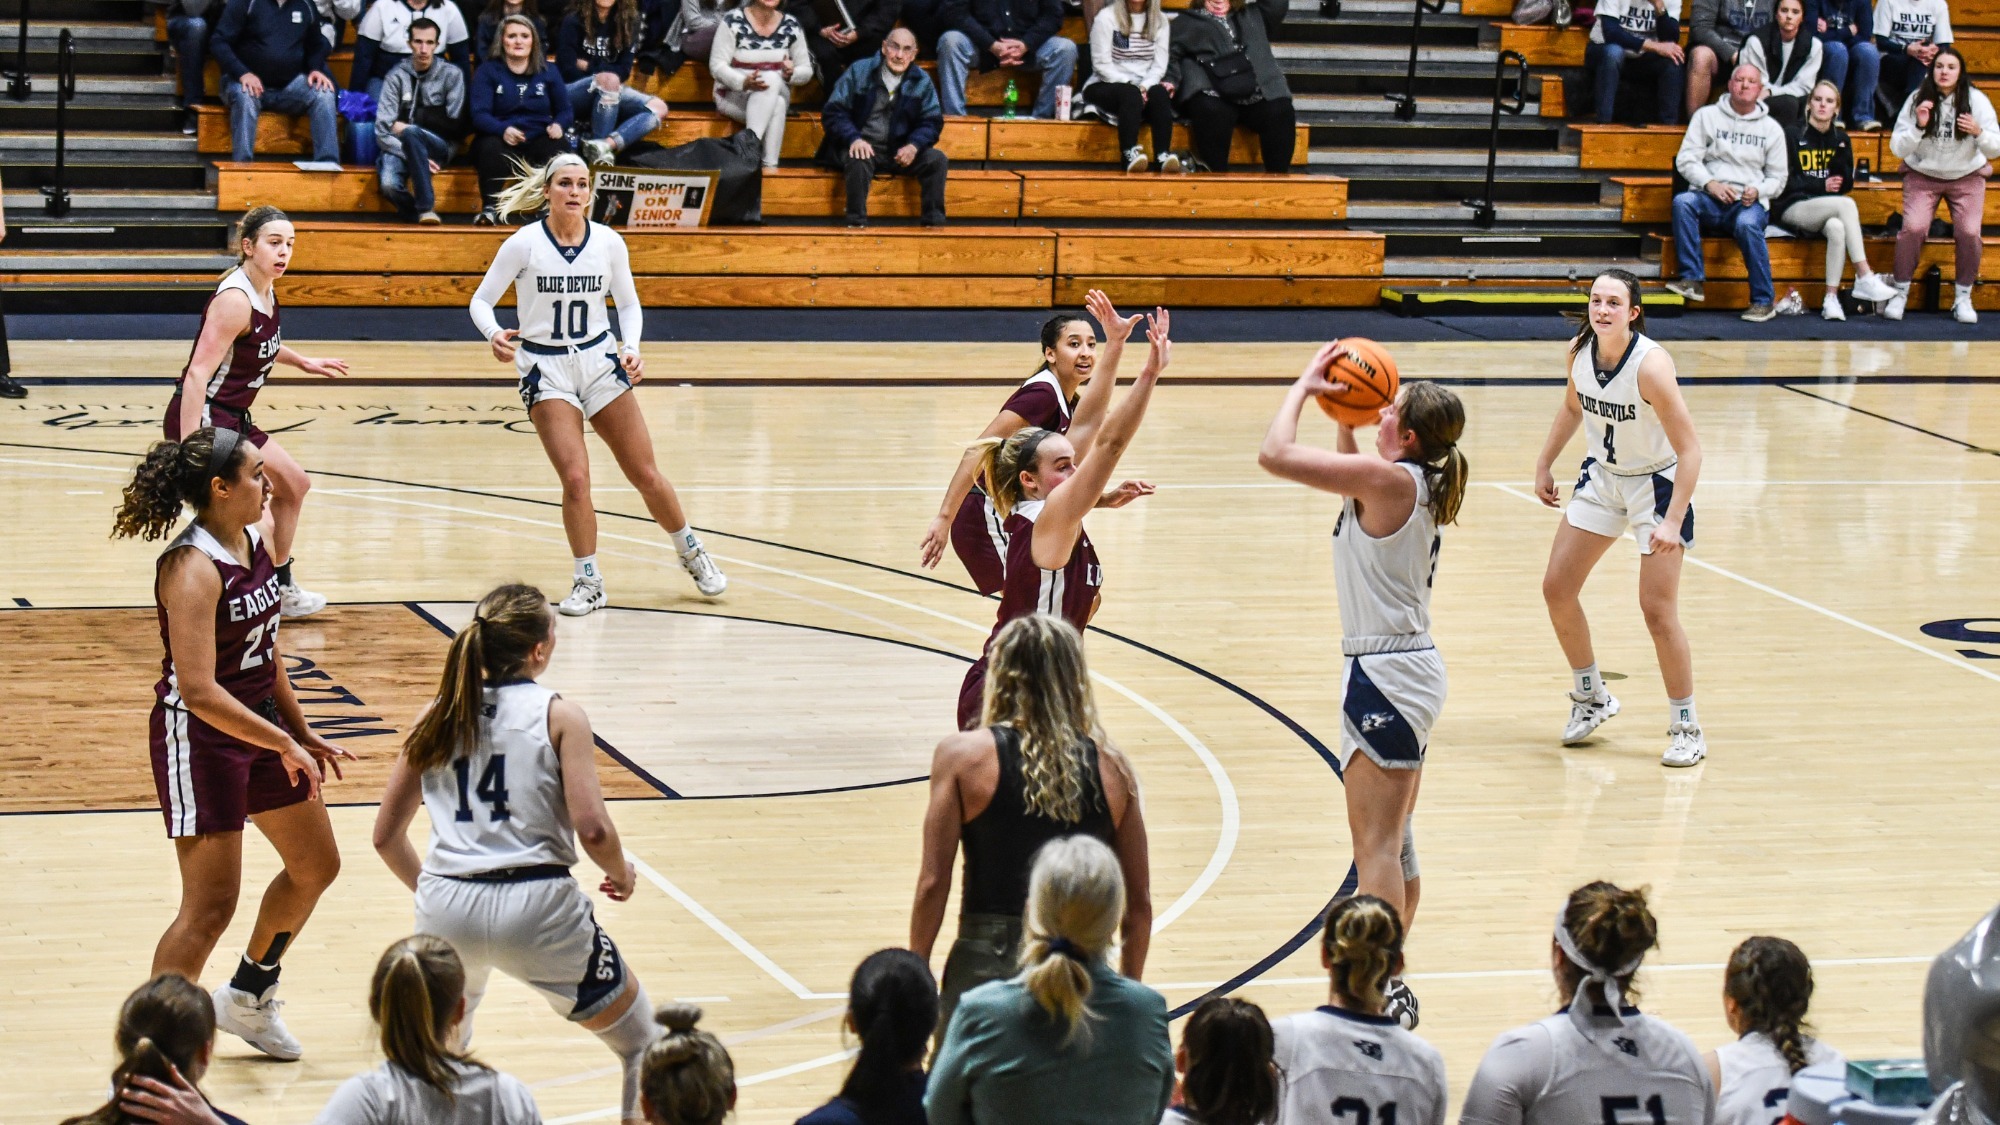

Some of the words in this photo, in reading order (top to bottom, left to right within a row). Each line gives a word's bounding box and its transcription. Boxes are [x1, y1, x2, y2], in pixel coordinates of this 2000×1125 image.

[1619, 14, 1656, 30] DEVIL
[1900, 12, 1933, 25] BLUE
[600, 173, 636, 188] SHINE
[637, 182, 686, 195] BRIGHT
[644, 197, 669, 207] ON
[633, 208, 683, 221] SENIOR
[536, 275, 564, 294] BLUE
[566, 275, 603, 293] DEVILS
[550, 299, 589, 340] 10
[1598, 399, 1636, 422] DEVILS
[1603, 422, 1617, 465] 4
[228, 573, 280, 623] EAGLE
[452, 753, 511, 822] 14
